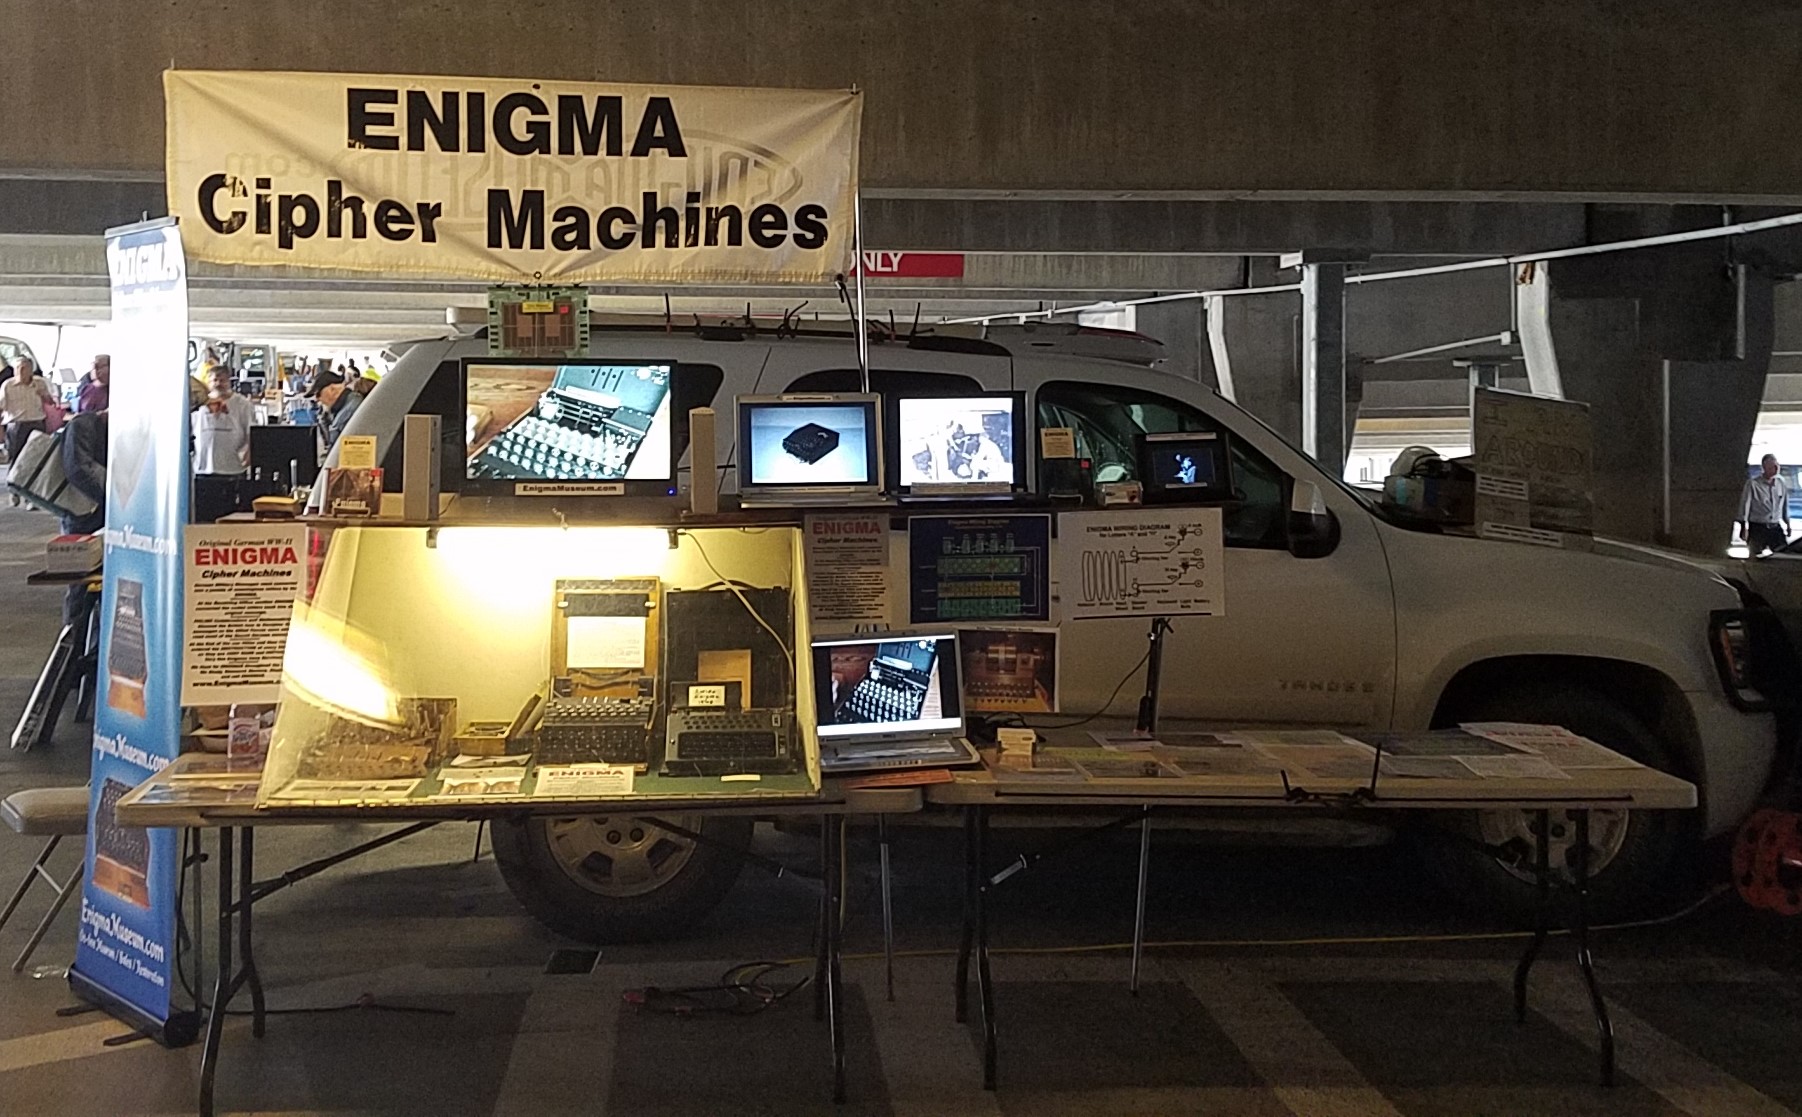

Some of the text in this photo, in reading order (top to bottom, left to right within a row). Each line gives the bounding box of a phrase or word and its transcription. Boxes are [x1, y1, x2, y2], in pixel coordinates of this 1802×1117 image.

[346, 87, 688, 157] ENIGMA
[198, 173, 828, 251] Cipher Machines
[850, 252, 903, 272] NLY
[523, 485, 617, 493] EnigmaMuseum.com
[813, 521, 882, 534] ENIGMA
[199, 539, 232, 548] Original
[234, 538, 265, 546] German
[195, 547, 298, 566] ENIGMA
[202, 568, 292, 579] Cipher Machines
